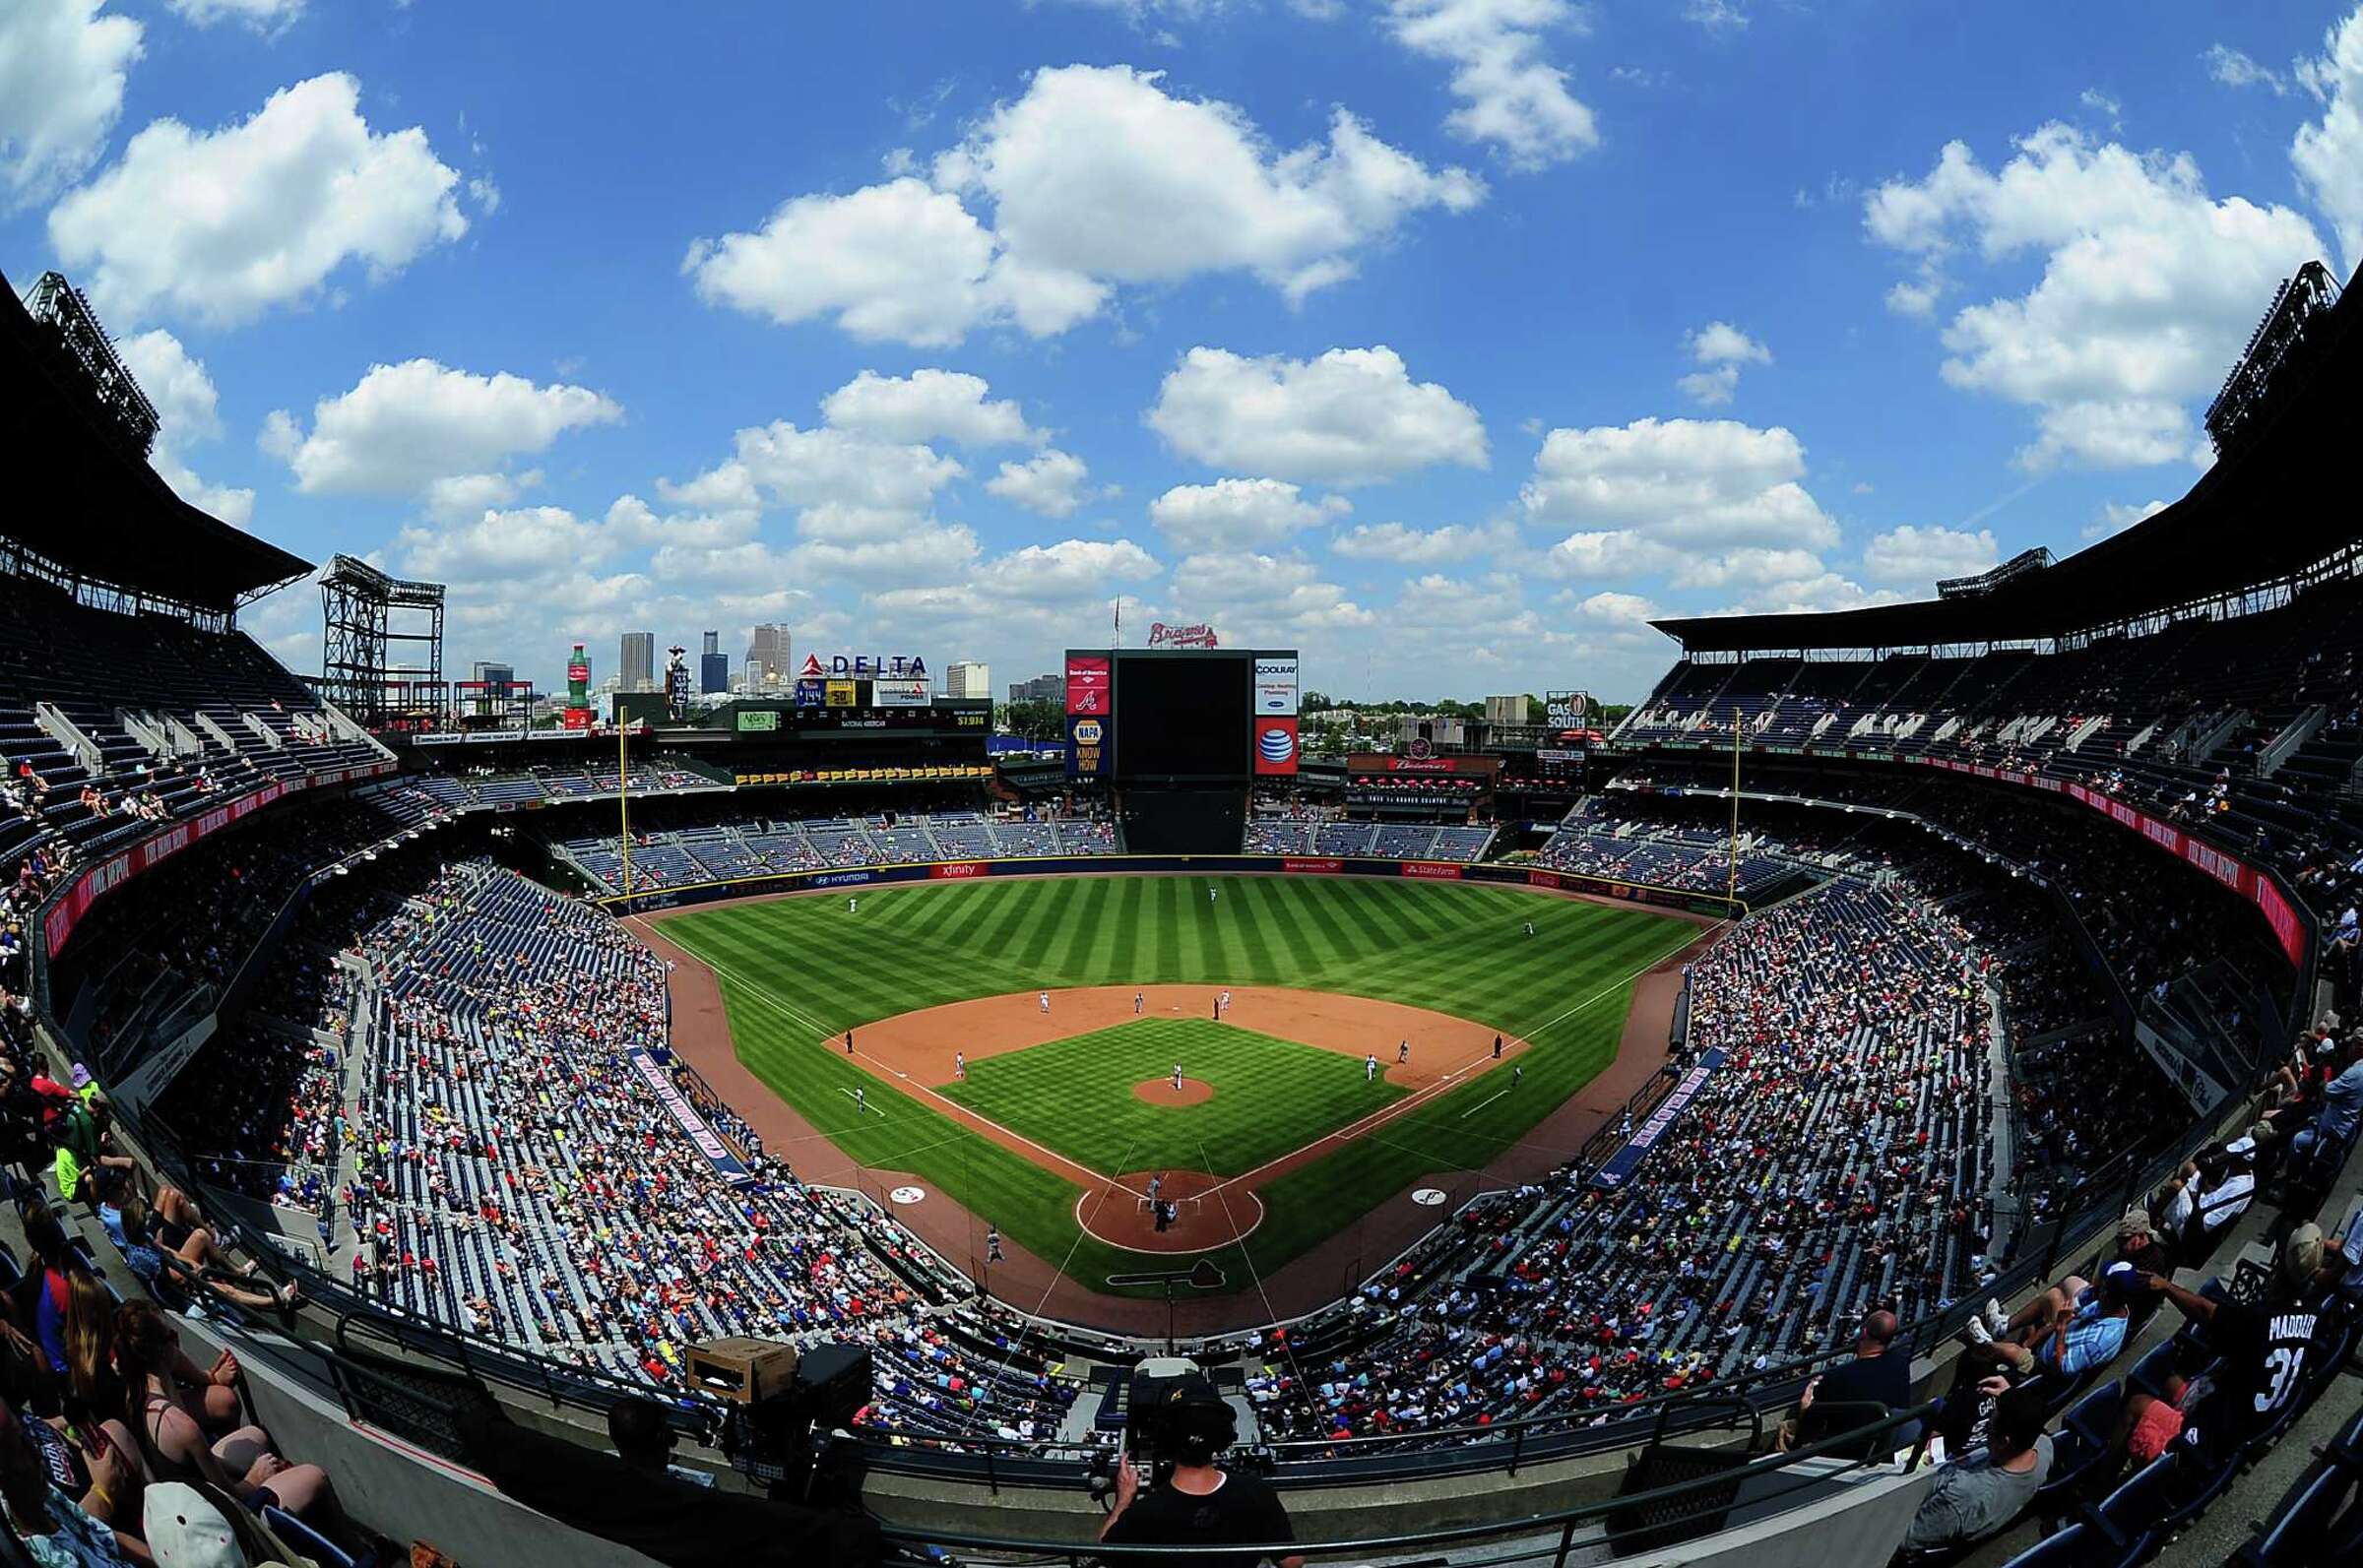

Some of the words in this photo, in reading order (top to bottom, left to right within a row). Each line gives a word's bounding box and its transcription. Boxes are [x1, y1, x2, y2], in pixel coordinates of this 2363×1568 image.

[1149, 622, 1206, 647] Braves
[833, 656, 926, 674] DELTA
[1255, 665, 1298, 674] COOLRAY
[1547, 704, 1570, 716] GAS
[1548, 716, 1585, 728] SOUTH
[1078, 726, 1099, 738] NAPA
[1076, 747, 1101, 759] KNOW
[1078, 759, 1098, 772] HOW
[942, 864, 976, 877] xfinity
[831, 873, 869, 883] HYUNDAI
[2268, 1313, 2318, 1342] MADDUX
[2254, 1347, 2305, 1412] 31
